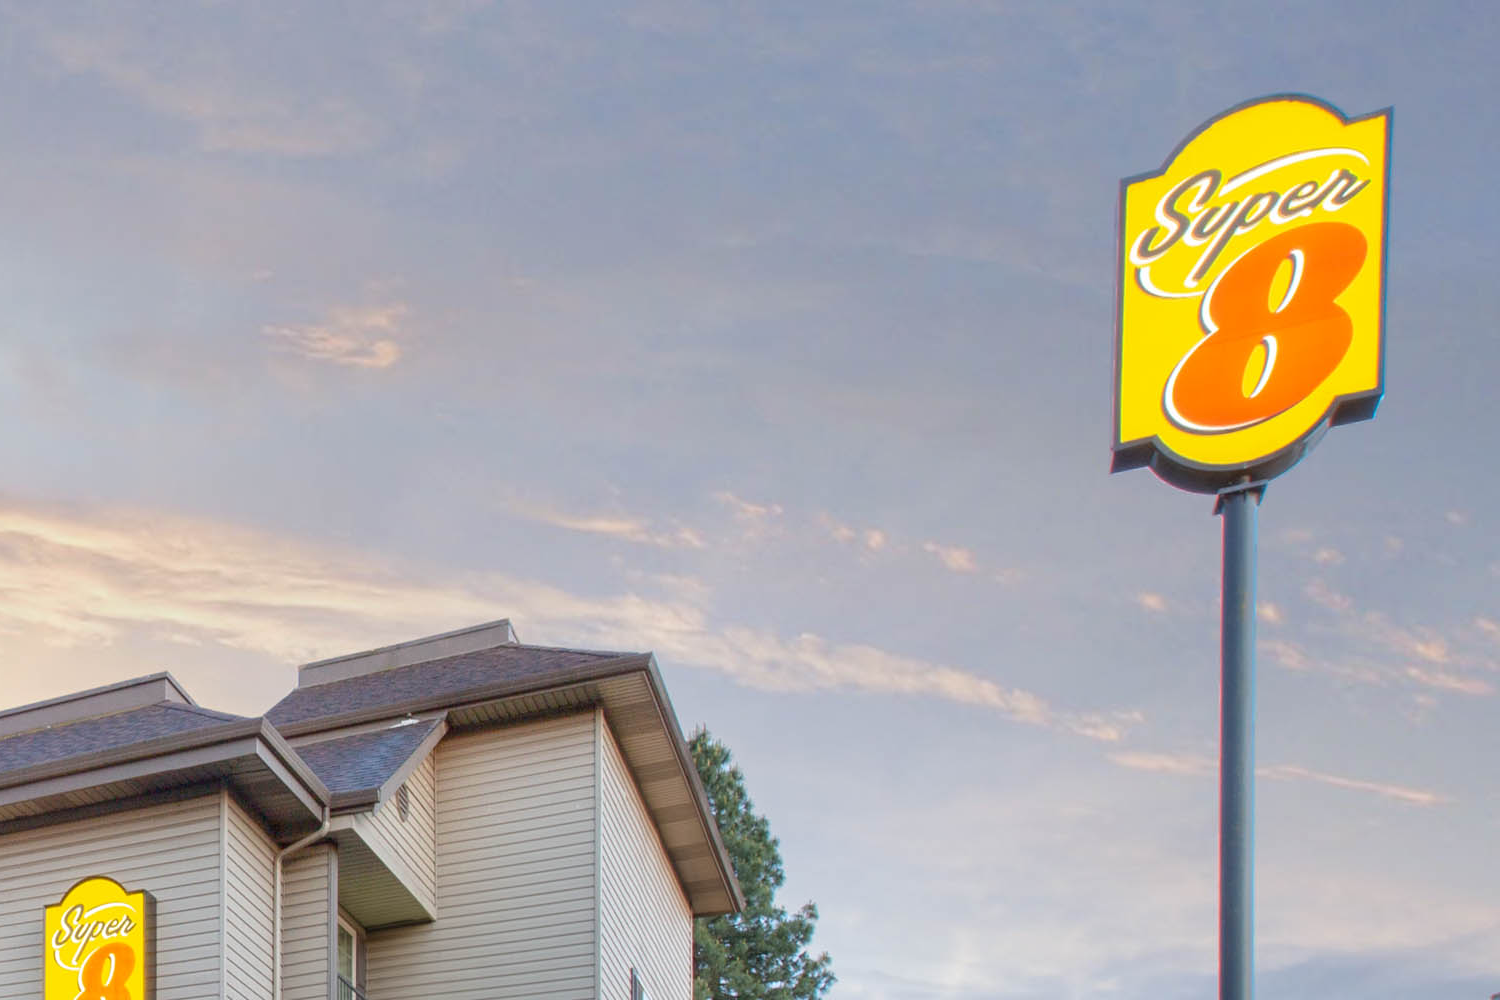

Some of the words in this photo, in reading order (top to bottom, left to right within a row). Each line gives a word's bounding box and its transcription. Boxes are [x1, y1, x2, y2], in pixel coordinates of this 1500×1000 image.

[1129, 166, 1372, 289] Super
[1161, 221, 1368, 435] 8
[51, 903, 137, 966] Super
